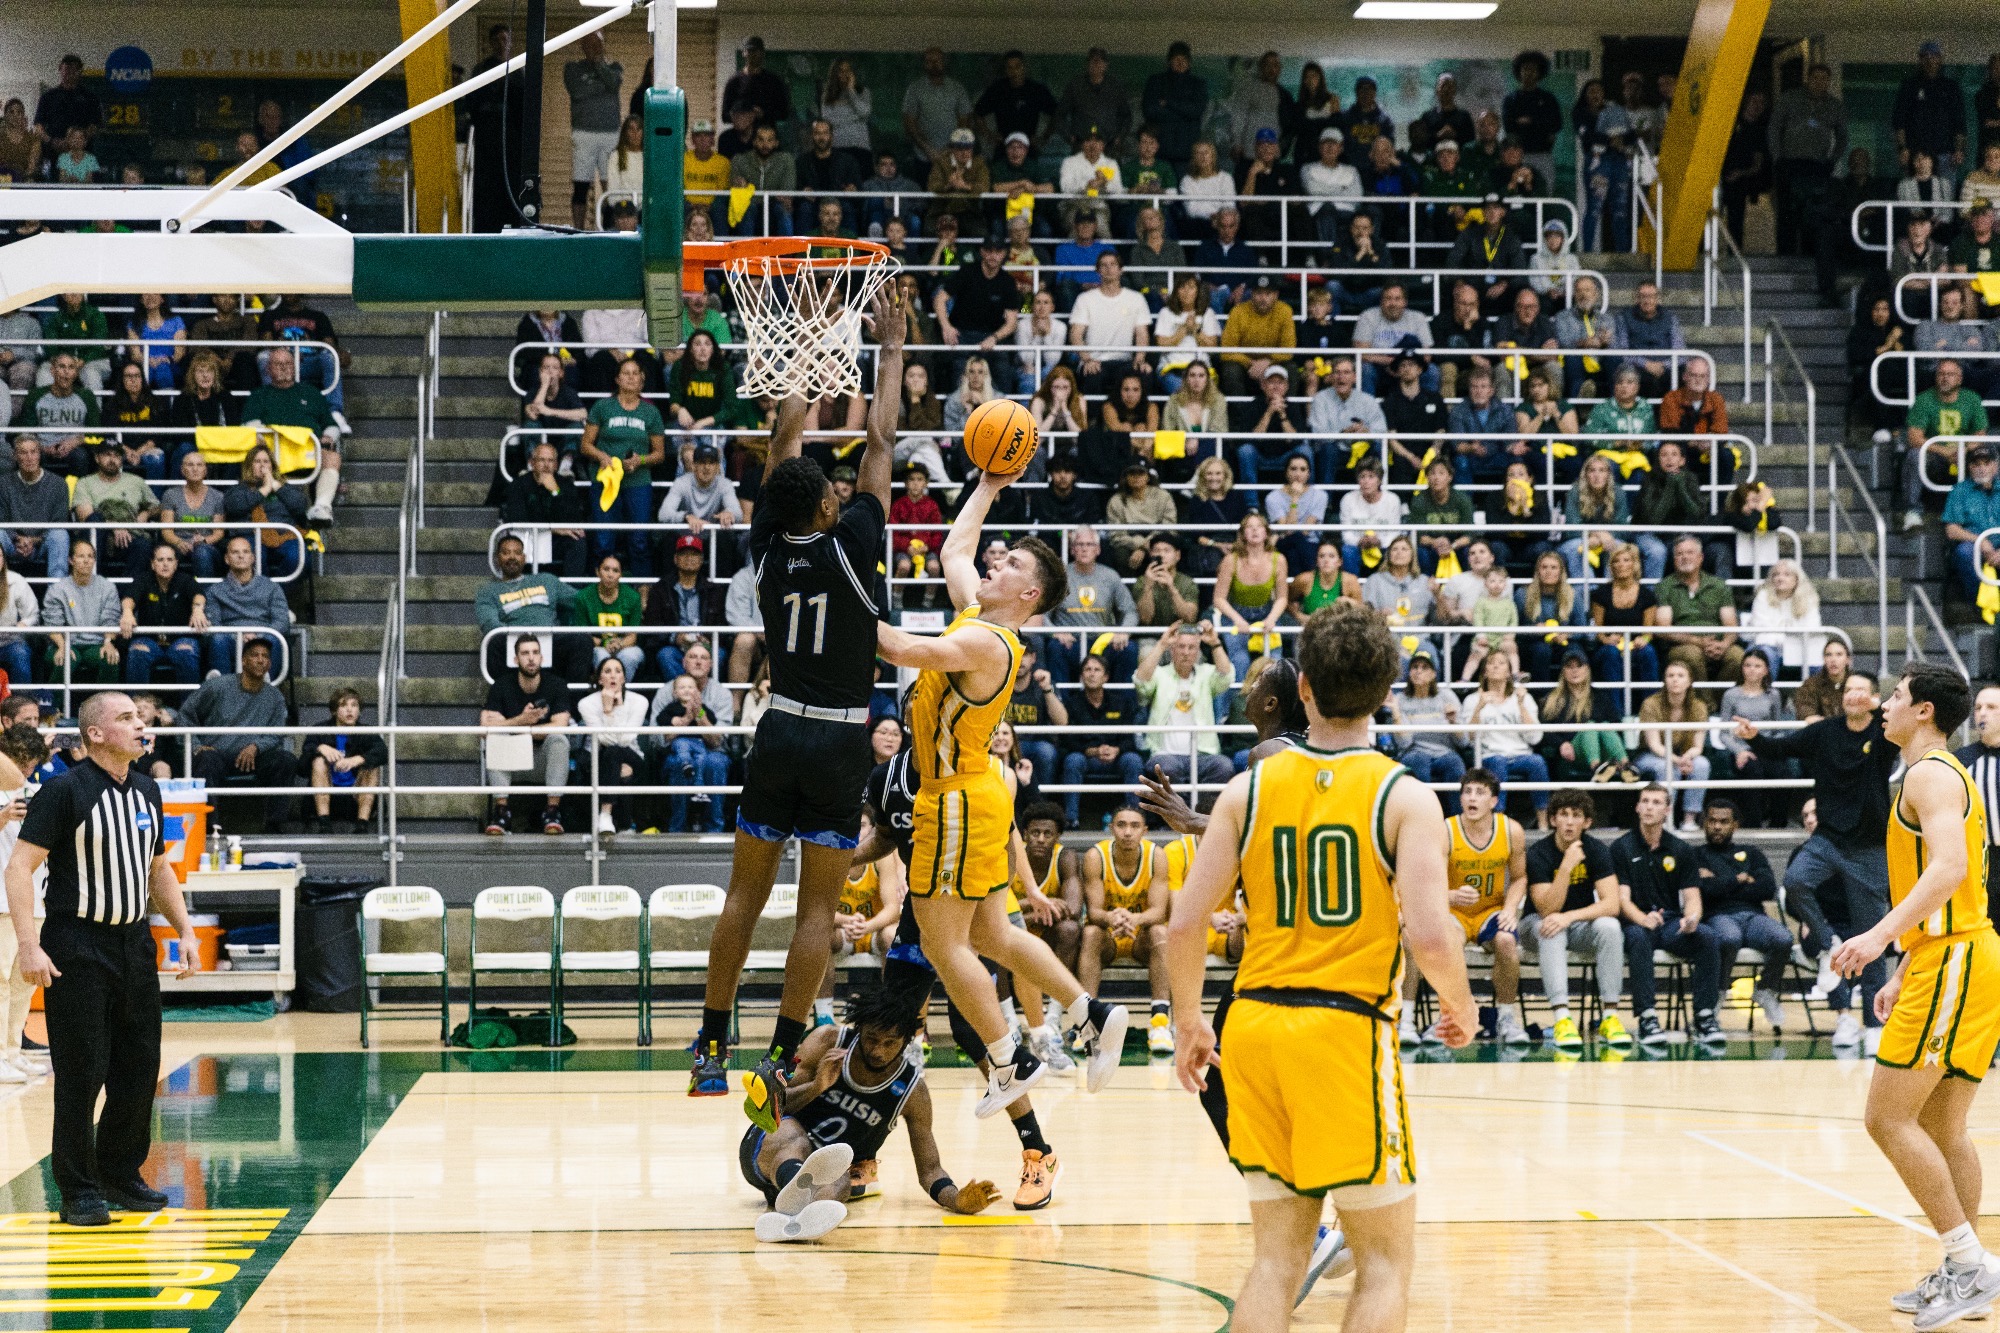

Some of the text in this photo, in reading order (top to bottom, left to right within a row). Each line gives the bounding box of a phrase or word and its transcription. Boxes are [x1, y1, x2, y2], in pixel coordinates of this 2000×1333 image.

[182, 50, 388, 68] BY THE NUMB
[110, 68, 150, 81] NCAA
[108, 104, 140, 125] 28
[40, 407, 81, 422] PLNU
[1002, 427, 1025, 462] NCAA
[783, 593, 828, 655] 11
[1273, 824, 1362, 928] 10
[376, 891, 430, 904] POINT LOMA
[487, 892, 542, 904] POINT LOMA
[575, 891, 629, 903] POINT LOMA
[662, 890, 715, 902] POINT LOMA
[778, 890, 798, 901] LOM
[819, 1089, 883, 1127] SUSB
